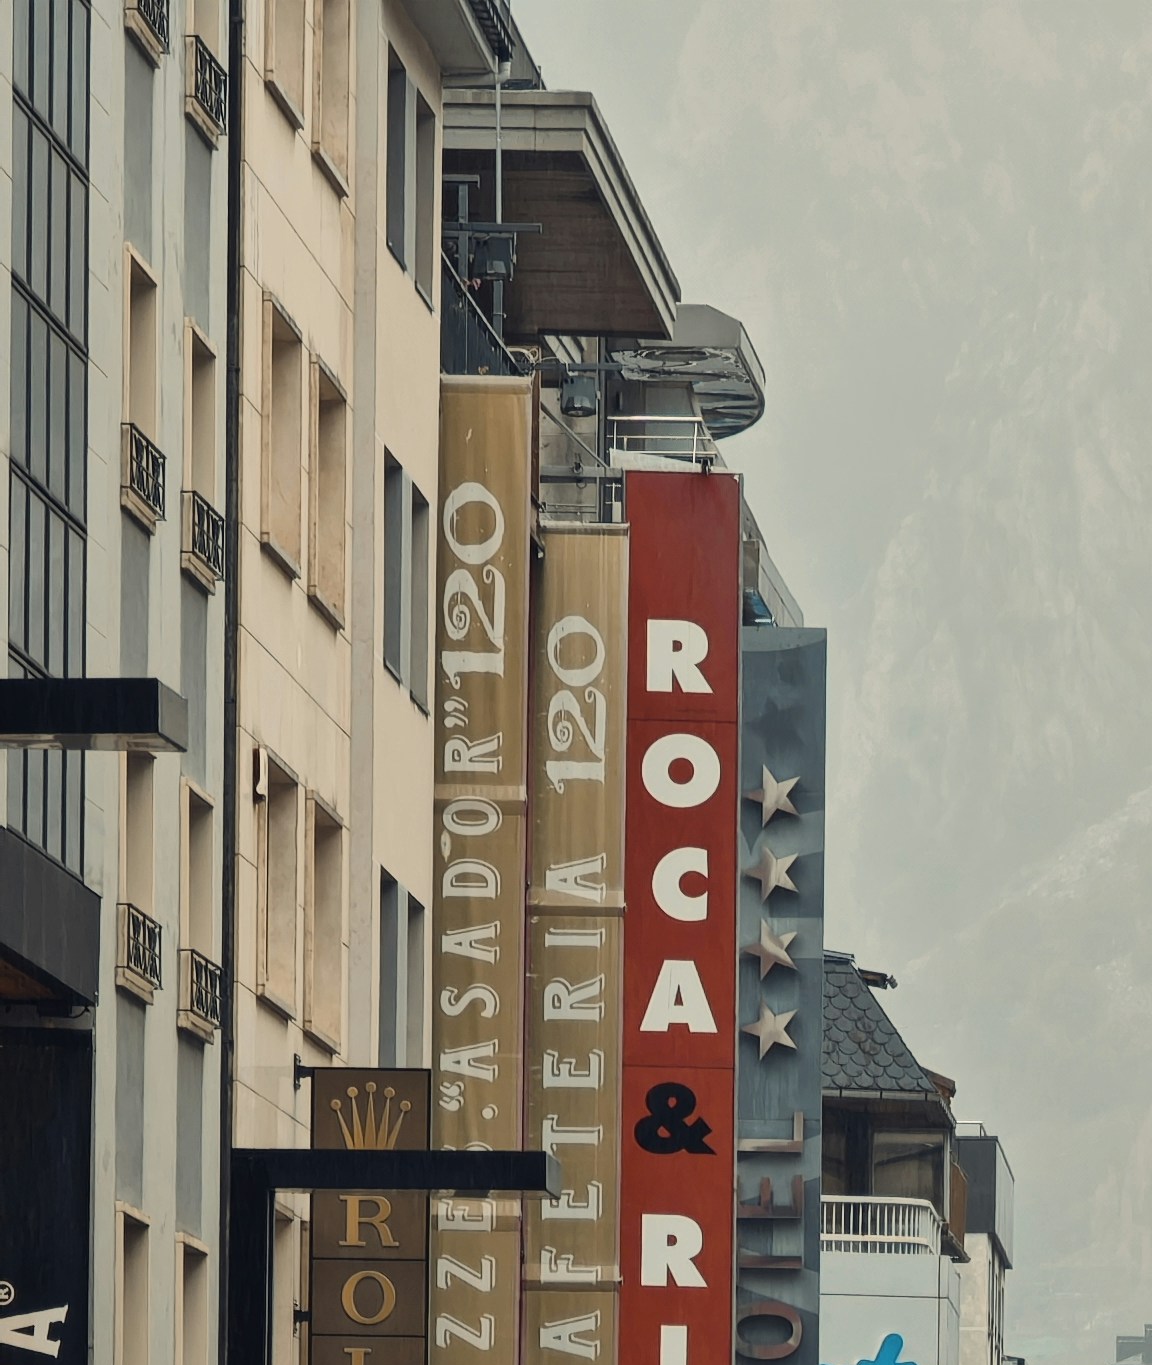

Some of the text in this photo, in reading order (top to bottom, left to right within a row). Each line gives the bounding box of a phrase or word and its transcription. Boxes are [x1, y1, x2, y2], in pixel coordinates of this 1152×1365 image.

[443, 480, 507, 692] 120
[546, 614, 606, 794] 120
[639, 619, 722, 1034] ROCA
[634, 1083, 718, 1157] &
